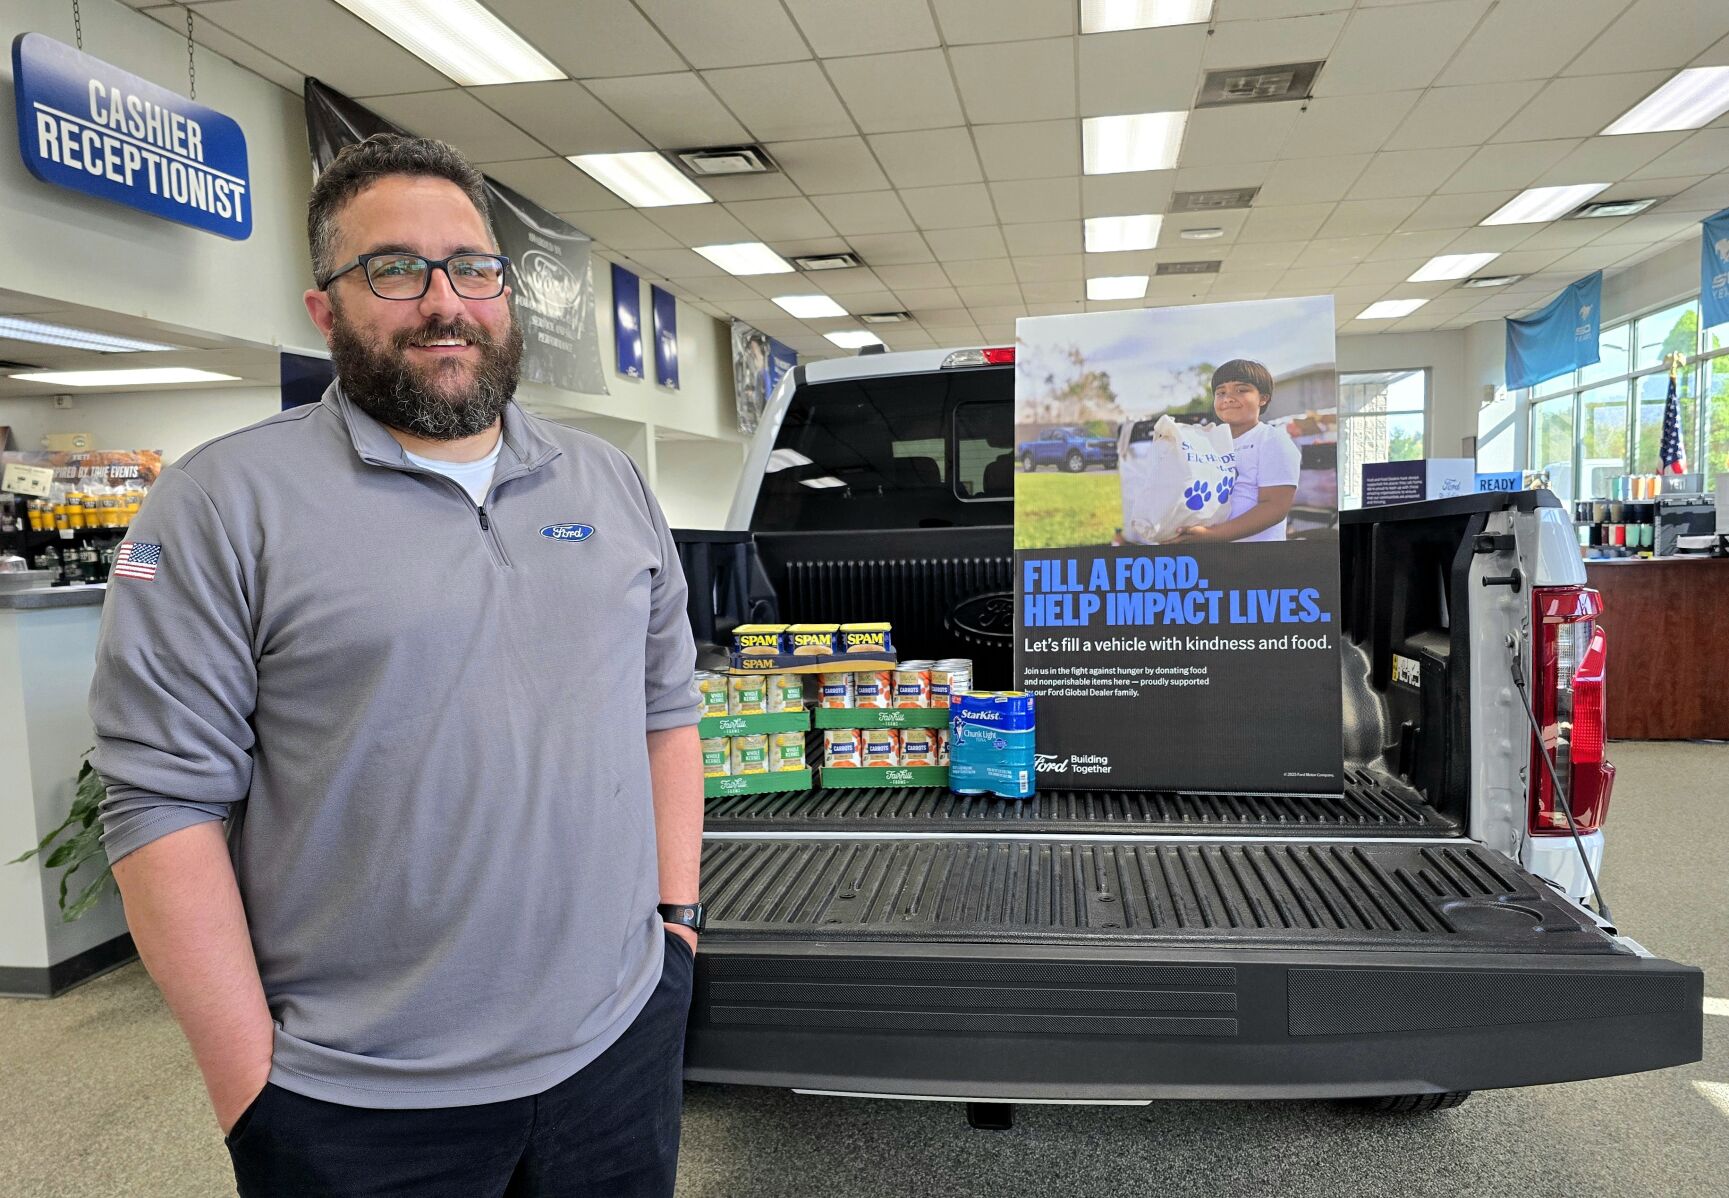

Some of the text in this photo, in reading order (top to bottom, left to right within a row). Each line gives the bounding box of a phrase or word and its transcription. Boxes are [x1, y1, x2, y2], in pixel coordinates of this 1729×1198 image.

[88, 79, 204, 162] CASHIER
[36, 111, 245, 223] RECEPTIONIST
[53, 466, 76, 479] PIRED
[78, 466, 89, 479] BY
[111, 465, 139, 479] EVENTS
[1480, 478, 1516, 491] READY
[1669, 479, 1686, 490] YETI
[552, 525, 583, 538] Ford
[1024, 556, 1208, 593] FILL A FORD.
[1024, 593, 1101, 627] HELP
[1106, 589, 1223, 625] IMPACT
[1229, 588, 1331, 624] LIVES.
[741, 635, 777, 646] SPAM
[795, 634, 831, 646] SPAM
[847, 633, 884, 645] SPAM
[1061, 637, 1080, 652] fill
[1083, 641, 1092, 652] a
[1094, 637, 1147, 652] vehicle
[1149, 637, 1183, 651] with
[1186, 636, 1256, 651] kindness
[1258, 635, 1288, 650] and
[1290, 634, 1332, 650] food.
[743, 659, 774, 668] SPAM
[1024, 667, 1039, 675] Join
[1050, 667, 1057, 675] in
[1058, 667, 1070, 675] the
[1071, 667, 1088, 677] fight
[1089, 667, 1116, 677] against
[1117, 667, 1144, 677] hunger
[1145, 667, 1154, 677] by
[1155, 666, 1189, 676] donating
[1190, 666, 1207, 675] food
[1024, 678, 1038, 686] and
[1039, 678, 1090, 687] nonperishable
[1091, 678, 1113, 686] items
[1114, 678, 1130, 686] here
[1141, 678, 1168, 687] proudly
[1170, 678, 1209, 687] supported
[1048, 688, 1064, 697] Ford
[1065, 688, 1089, 697] Global
[1090, 688, 1113, 697] Dealer
[1114, 688, 1139, 699] family.
[961, 709, 999, 720] StarKist
[963, 730, 997, 740] Chunk Light
[1033, 753, 1069, 773] Ford
[1071, 754, 1108, 765] Building
[1071, 764, 1112, 774] Together
